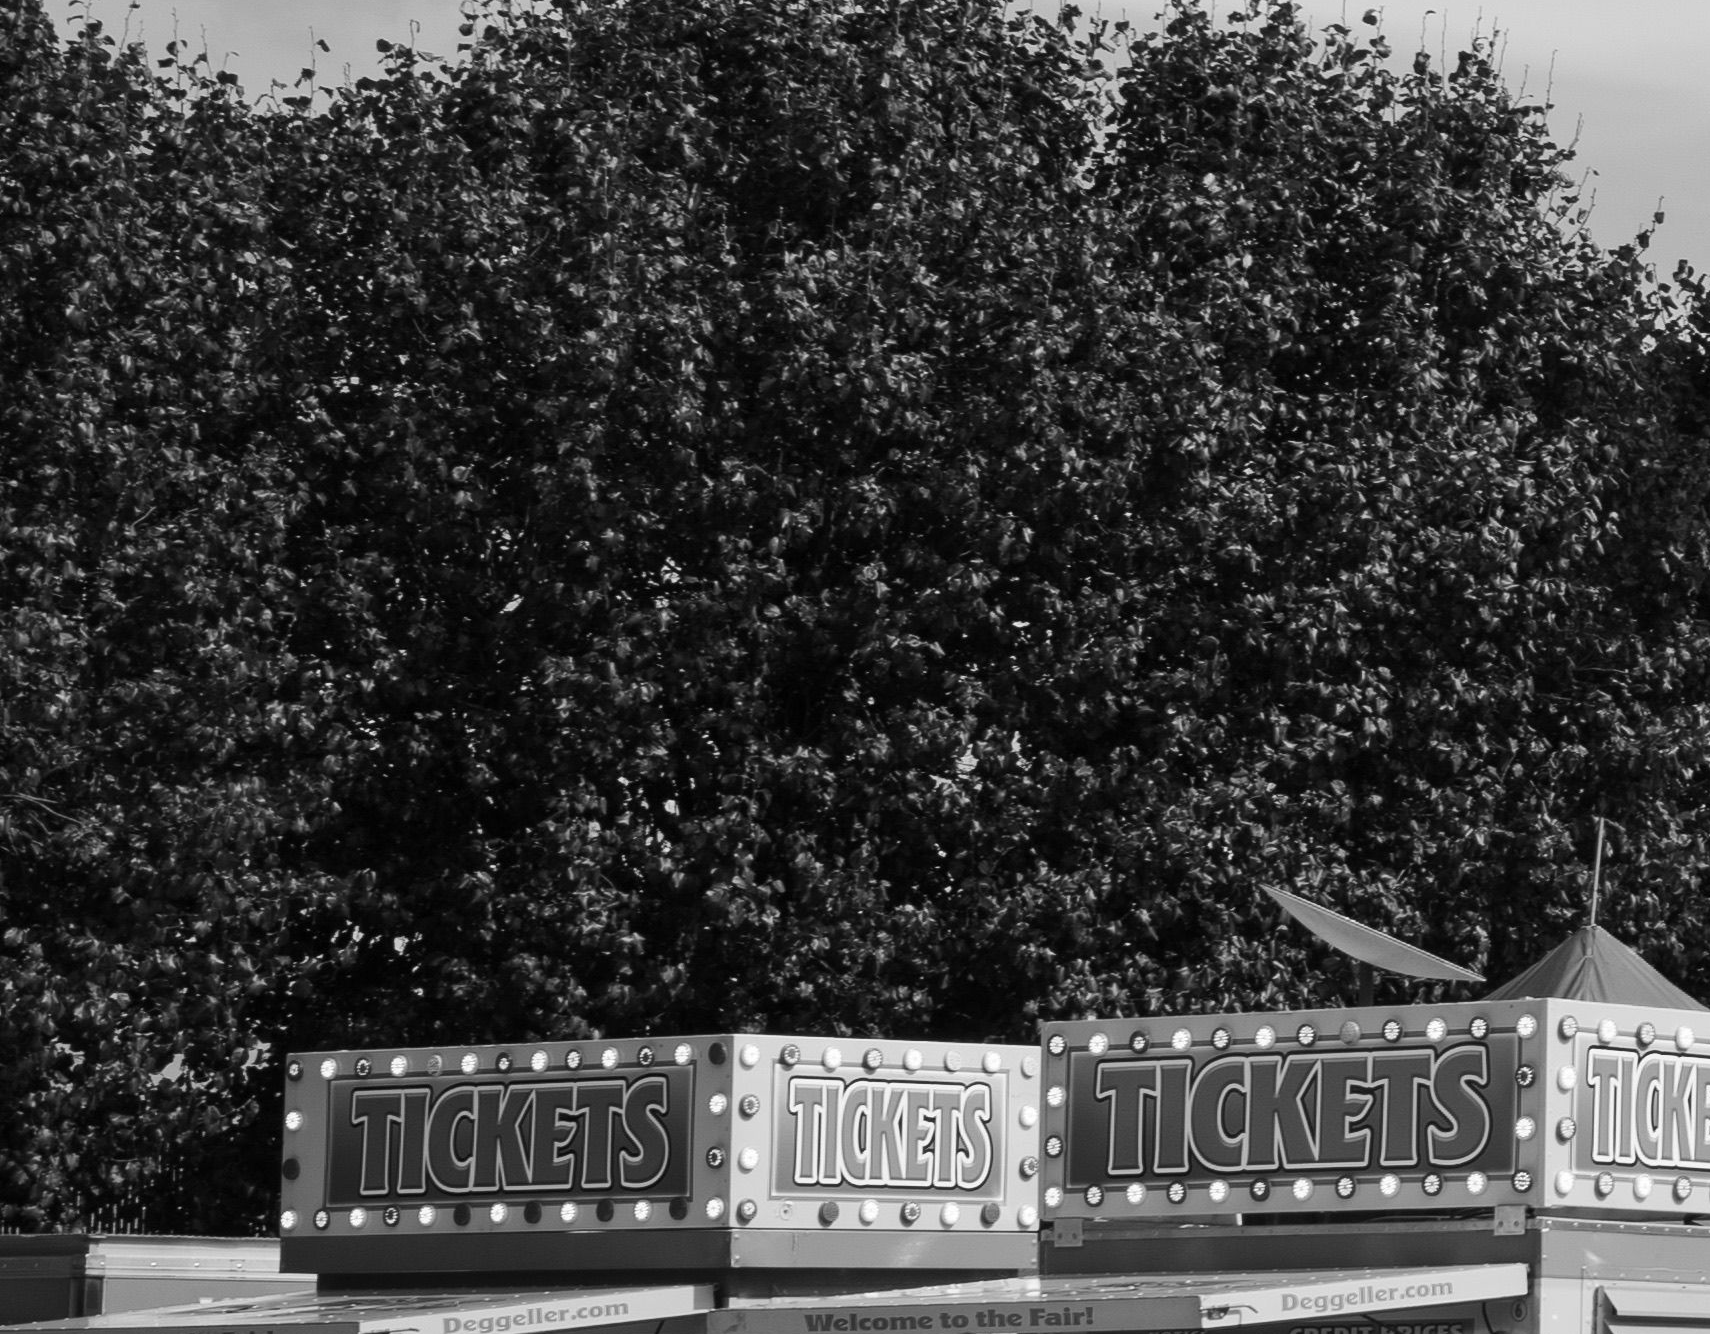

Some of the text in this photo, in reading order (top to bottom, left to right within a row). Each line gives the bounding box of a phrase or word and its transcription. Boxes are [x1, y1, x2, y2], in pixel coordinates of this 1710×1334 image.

[353, 1077, 669, 1194] TICKETS
[789, 1078, 991, 1188] TICKETS
[1096, 1046, 1490, 1174] TICKETS
[442, 1302, 630, 1334] Deggeller.com
[804, 1306, 1095, 1333] Welcome to the Fair!
[1281, 1281, 1454, 1313] Deggeller.com
